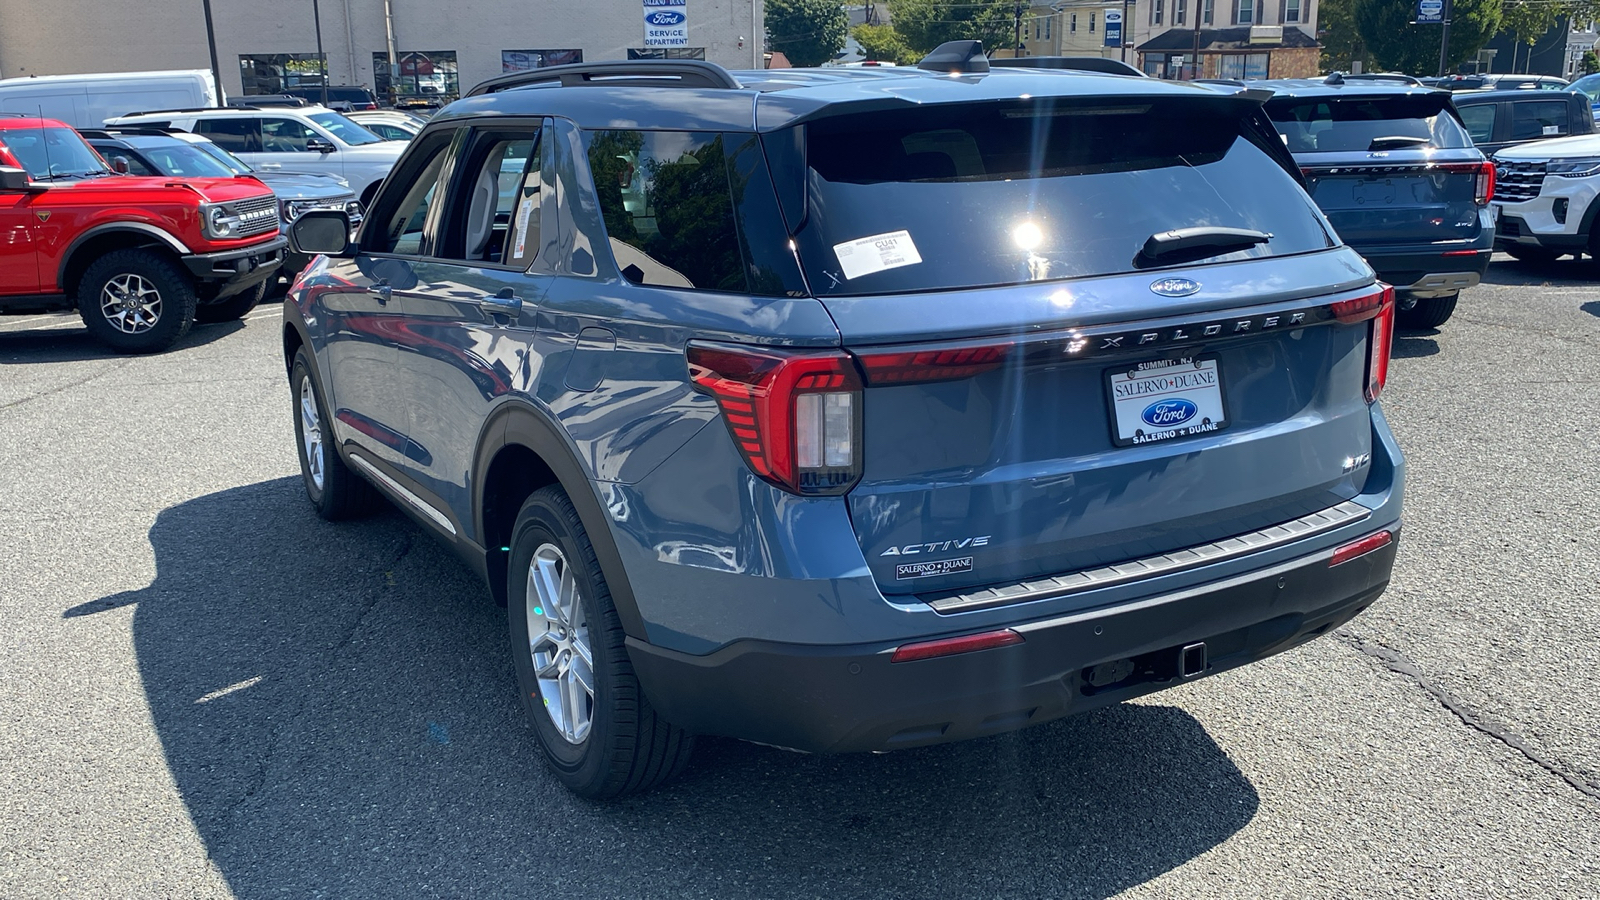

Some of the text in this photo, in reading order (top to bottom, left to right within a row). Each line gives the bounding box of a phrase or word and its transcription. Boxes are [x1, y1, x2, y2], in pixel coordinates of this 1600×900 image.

[653, 12, 678, 24] Ford
[874, 238, 898, 249] CU41
[1063, 312, 1306, 354] EXPLORER
[1180, 356, 1193, 365] NJ
[1115, 371, 1216, 398] SALERNO DUANE
[1152, 402, 1187, 424] Ford
[1132, 422, 1219, 445] SALERNO DUANE
[880, 535, 992, 557] ACTIVE
[898, 558, 971, 575] SALERNO DUANE
